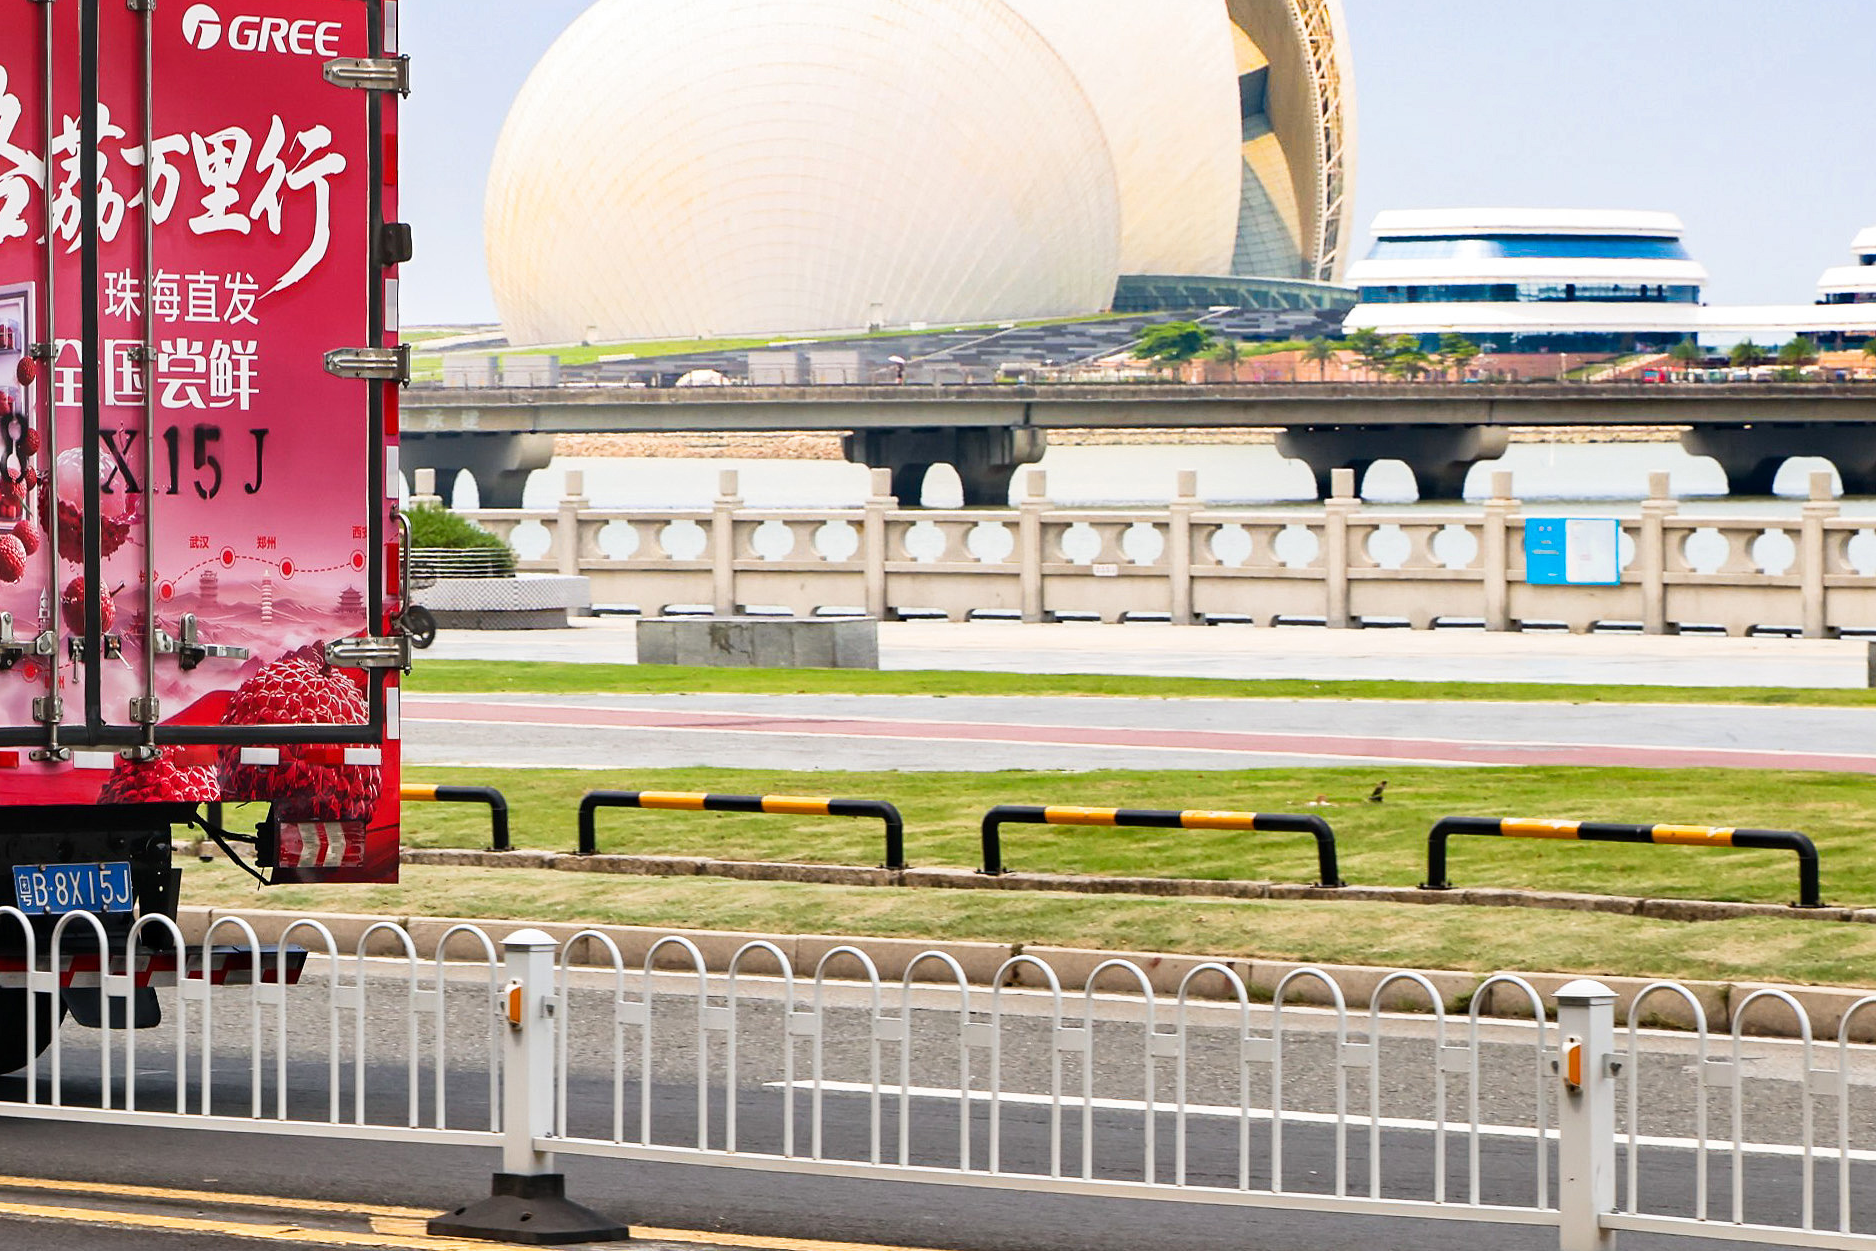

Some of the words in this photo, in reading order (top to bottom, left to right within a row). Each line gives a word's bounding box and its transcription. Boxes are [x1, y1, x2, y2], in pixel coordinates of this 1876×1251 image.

[227, 14, 343, 57] GREE
[103, 267, 260, 325] 珠海直发
[45, 337, 260, 411] 全国尝鲜
[189, 535, 210, 549] 武汉
[256, 535, 277, 550] 郑州
